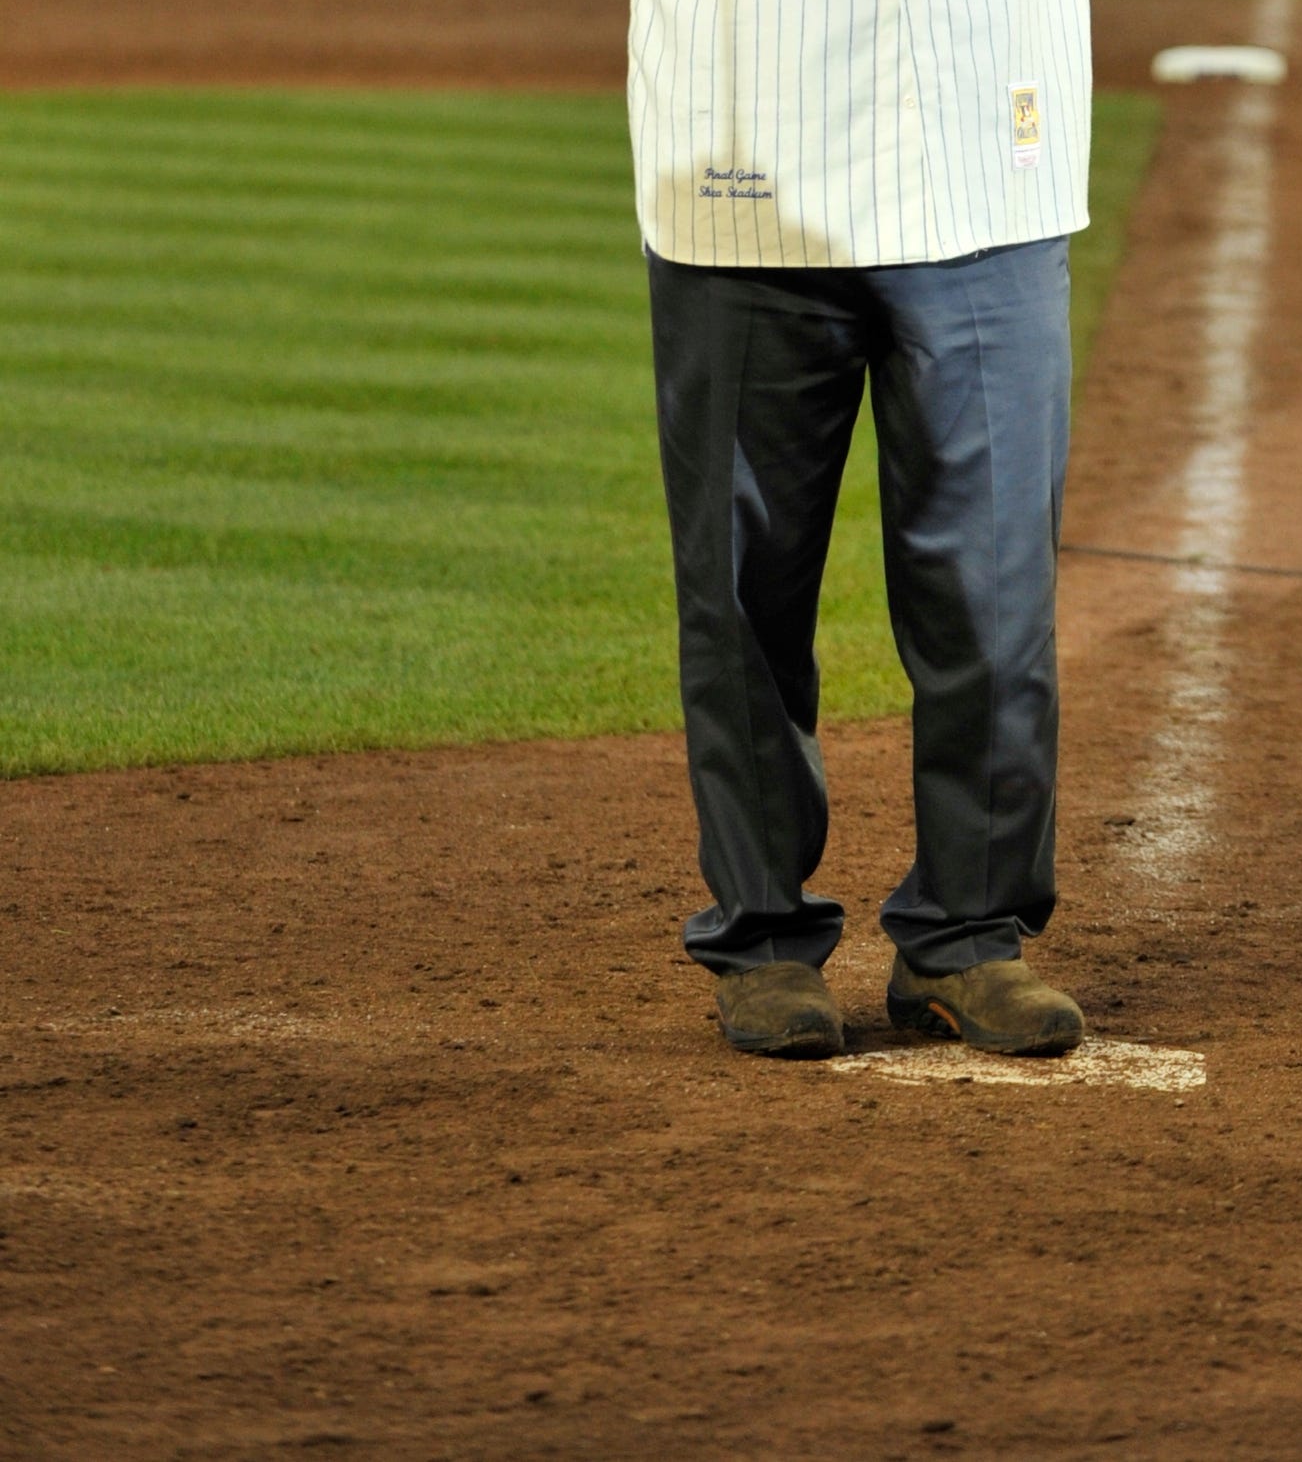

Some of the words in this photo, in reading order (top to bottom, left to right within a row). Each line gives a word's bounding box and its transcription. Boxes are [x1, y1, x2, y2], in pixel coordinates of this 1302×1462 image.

[704, 167, 734, 180] Final
[735, 168, 767, 183] Game
[698, 185, 722, 198] Shea
[726, 185, 773, 199] Stadium
